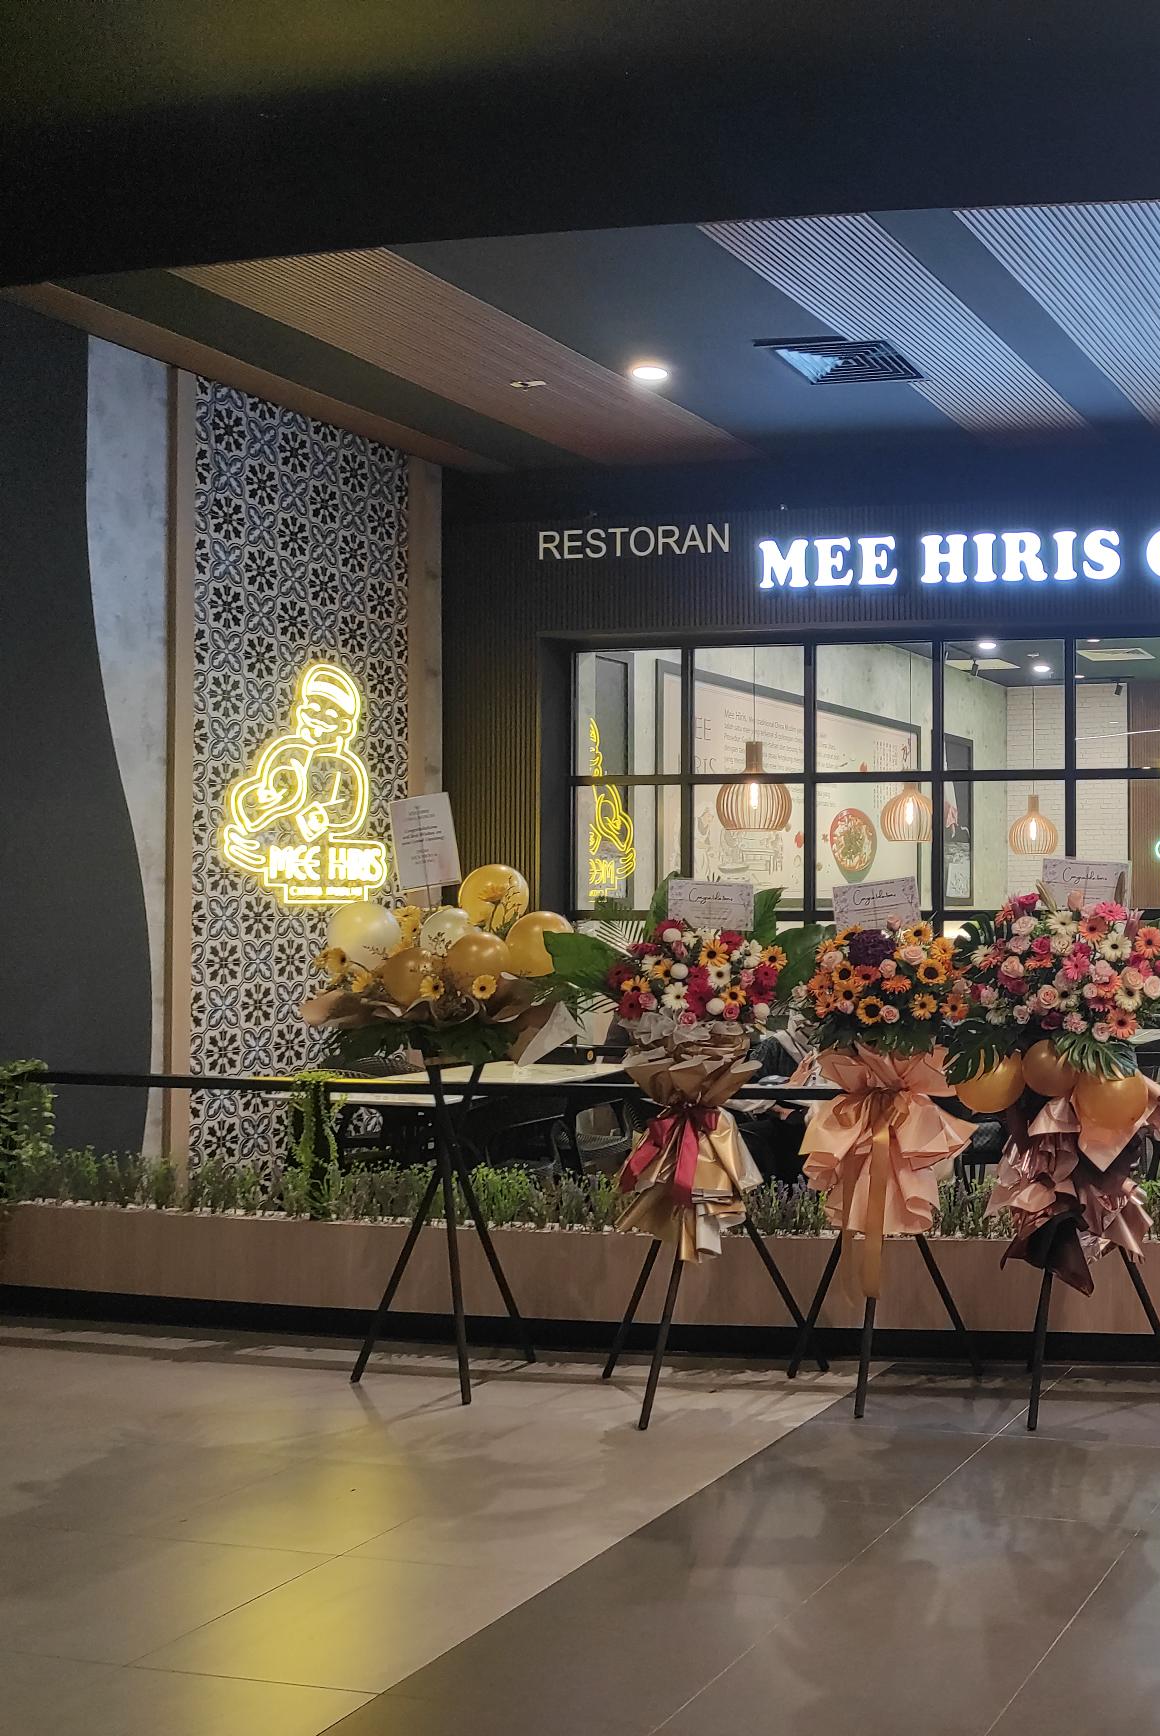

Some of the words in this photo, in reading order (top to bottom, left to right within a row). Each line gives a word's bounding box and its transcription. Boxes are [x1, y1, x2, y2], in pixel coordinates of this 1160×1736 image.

[538, 522, 731, 561] RESTORAN
[757, 534, 898, 590] MEE
[919, 527, 1122, 585] HIRIS
